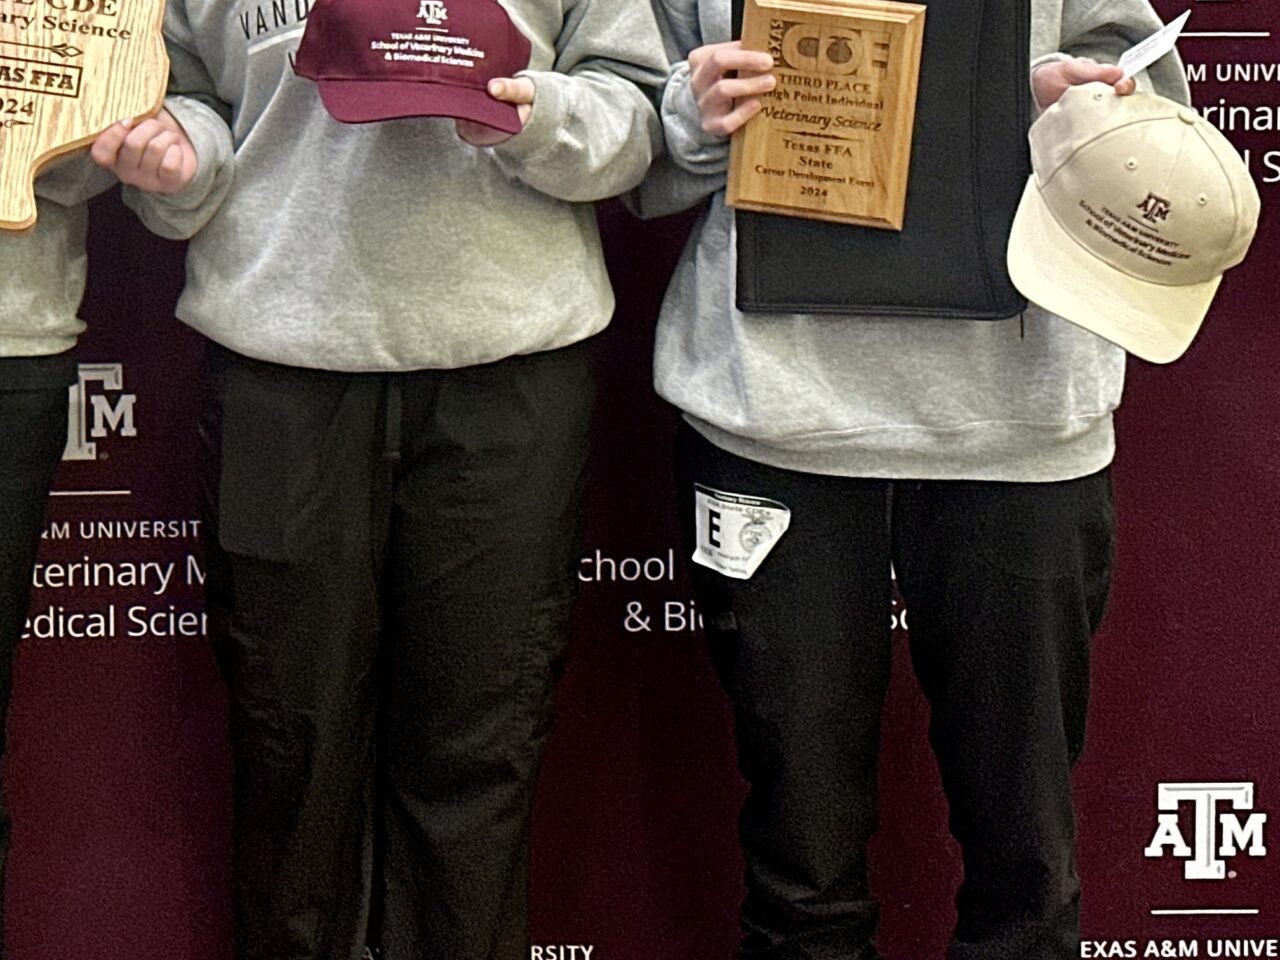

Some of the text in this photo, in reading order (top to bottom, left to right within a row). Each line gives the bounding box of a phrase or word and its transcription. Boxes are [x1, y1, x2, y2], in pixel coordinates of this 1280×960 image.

[41, 15, 132, 40] Science
[371, 41, 399, 50] School
[399, 41, 410, 50] of
[29, 70, 74, 90] FFA
[778, 73, 872, 95] THIRD PLACE
[793, 90, 821, 103] Point
[825, 93, 884, 110] Individual
[760, 106, 882, 132] Veterinary Science
[783, 138, 853, 158] Texas FFA
[799, 155, 834, 170] State
[754, 164, 785, 177] Career
[788, 168, 846, 184] Development
[800, 185, 828, 198] 2024
[1078, 199, 1104, 222] School
[708, 508, 721, 549] E
[623, 600, 652, 633] &
[1143, 939, 1199, 958] A&M
